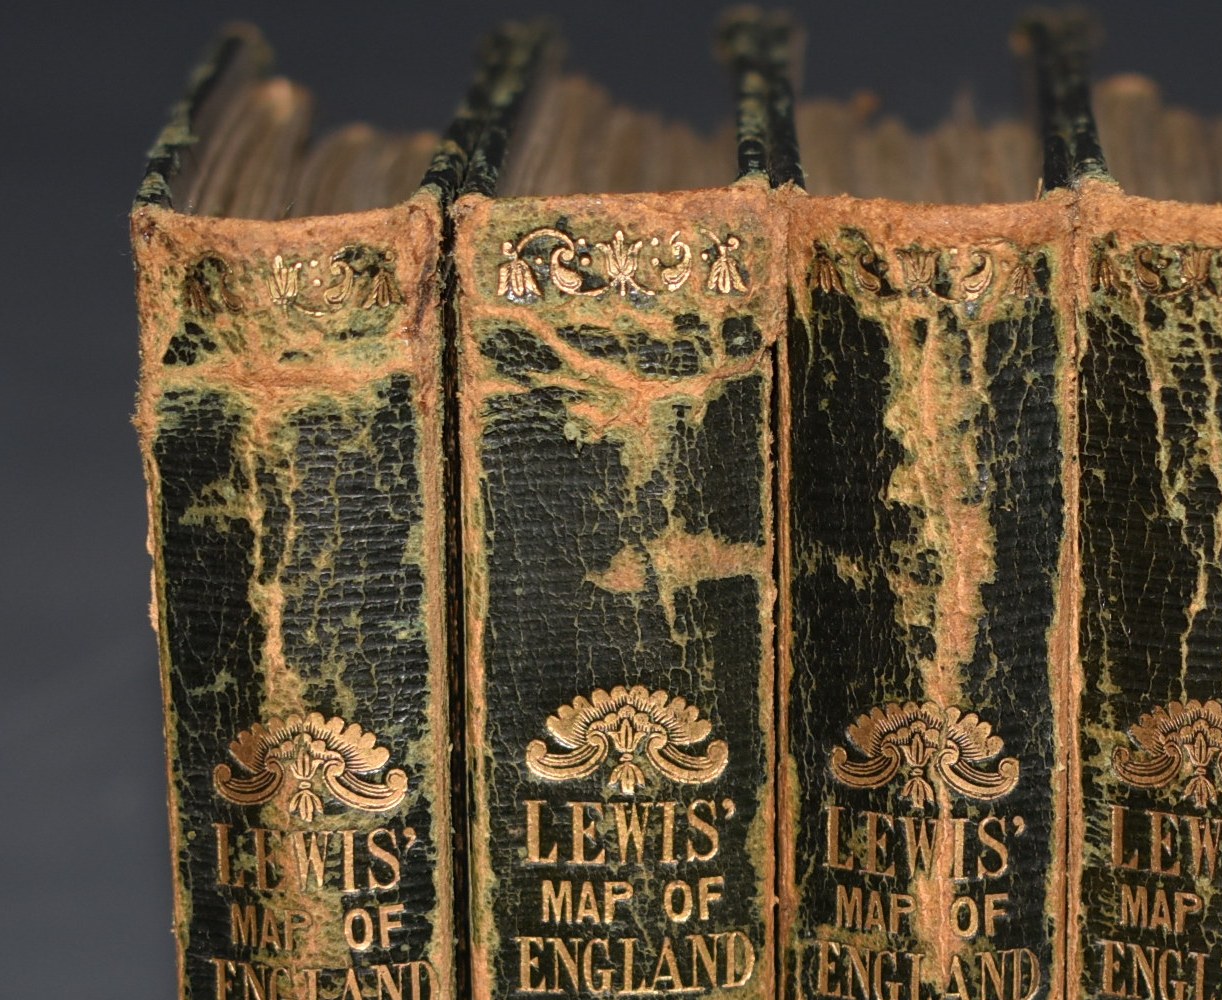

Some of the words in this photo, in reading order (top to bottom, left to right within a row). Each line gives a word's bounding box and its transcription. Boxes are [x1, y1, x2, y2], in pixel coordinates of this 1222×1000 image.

[522, 798, 737, 864] LEWIS'
[541, 879, 634, 925] MAP
[663, 875, 726, 923] OF
[836, 885, 916, 935] MAP
[951, 893, 1009, 938] OF
[1120, 884, 1202, 934] MAP
[230, 903, 313, 951] MAP
[343, 903, 406, 951] OF
[513, 931, 756, 994] ENGLAND
